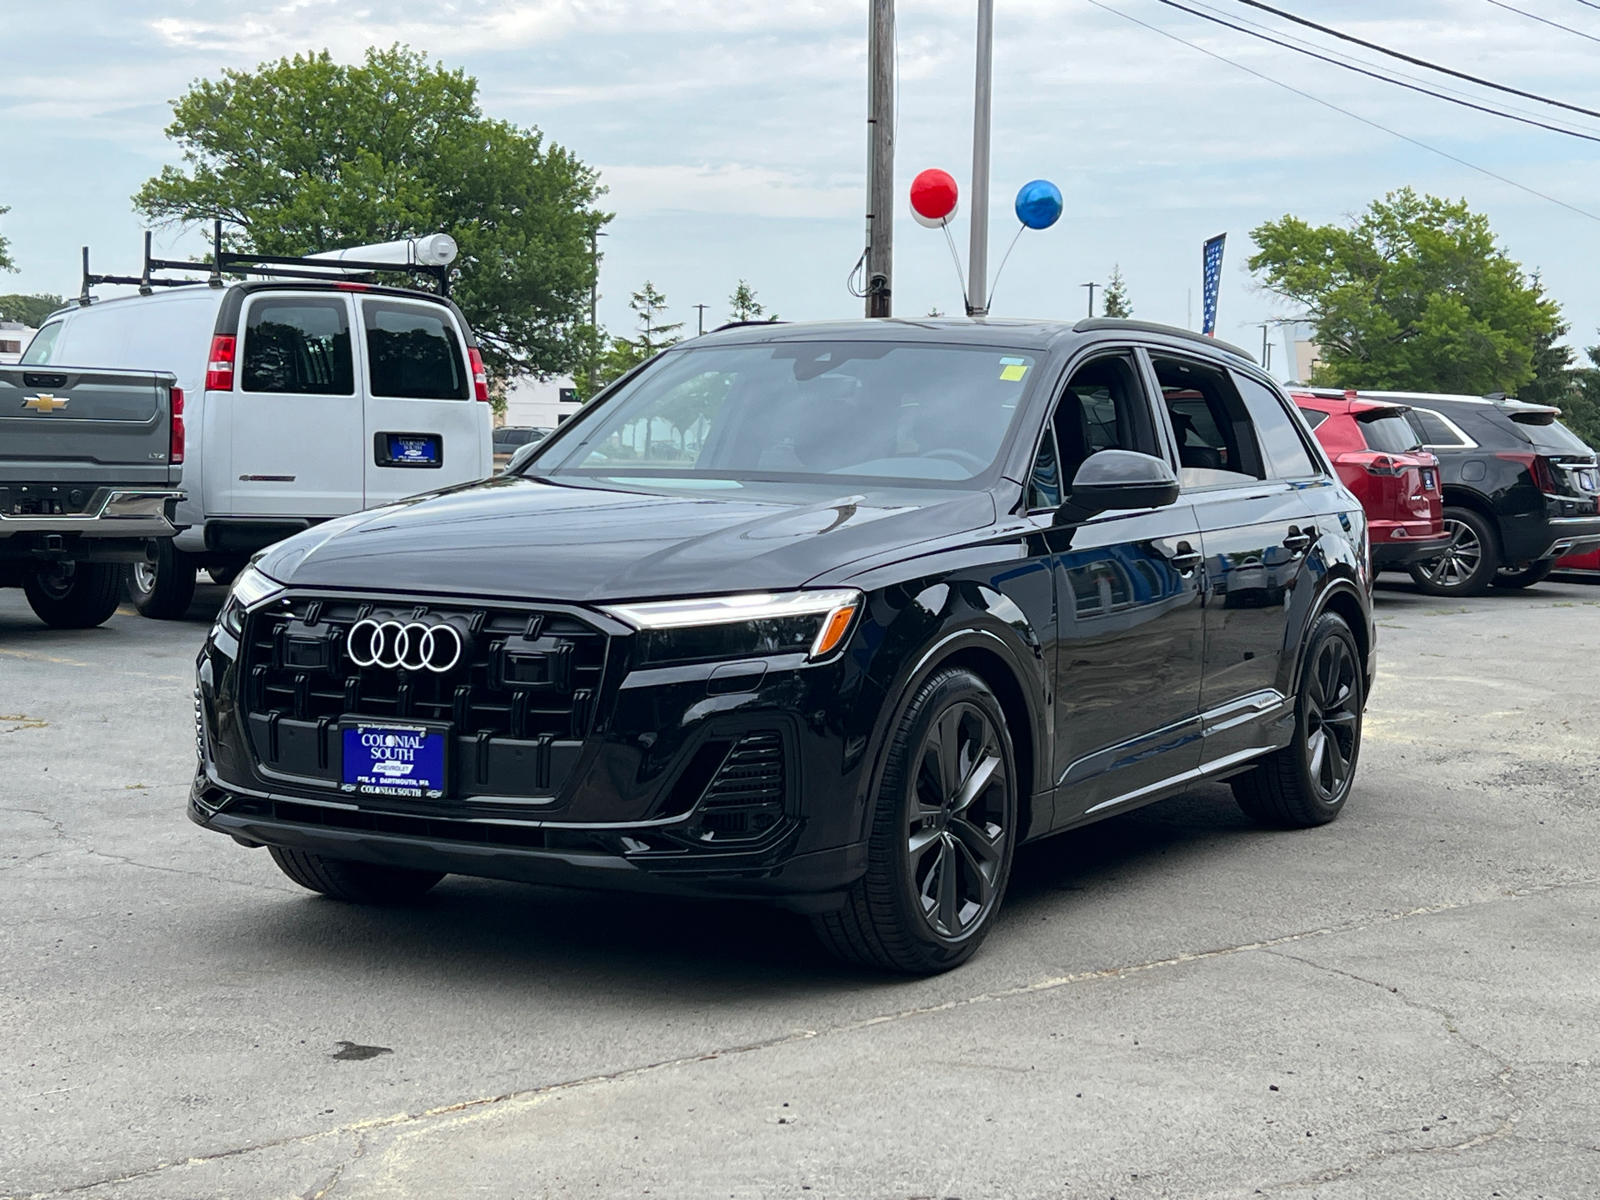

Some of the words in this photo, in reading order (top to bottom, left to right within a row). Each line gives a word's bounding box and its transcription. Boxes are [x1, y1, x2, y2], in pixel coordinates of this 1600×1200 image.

[361, 734, 424, 749] COLONIAL
[370, 747, 414, 761] SOUTH
[361, 786, 397, 795] COLONIAL
[397, 788, 421, 797] SOUTH
